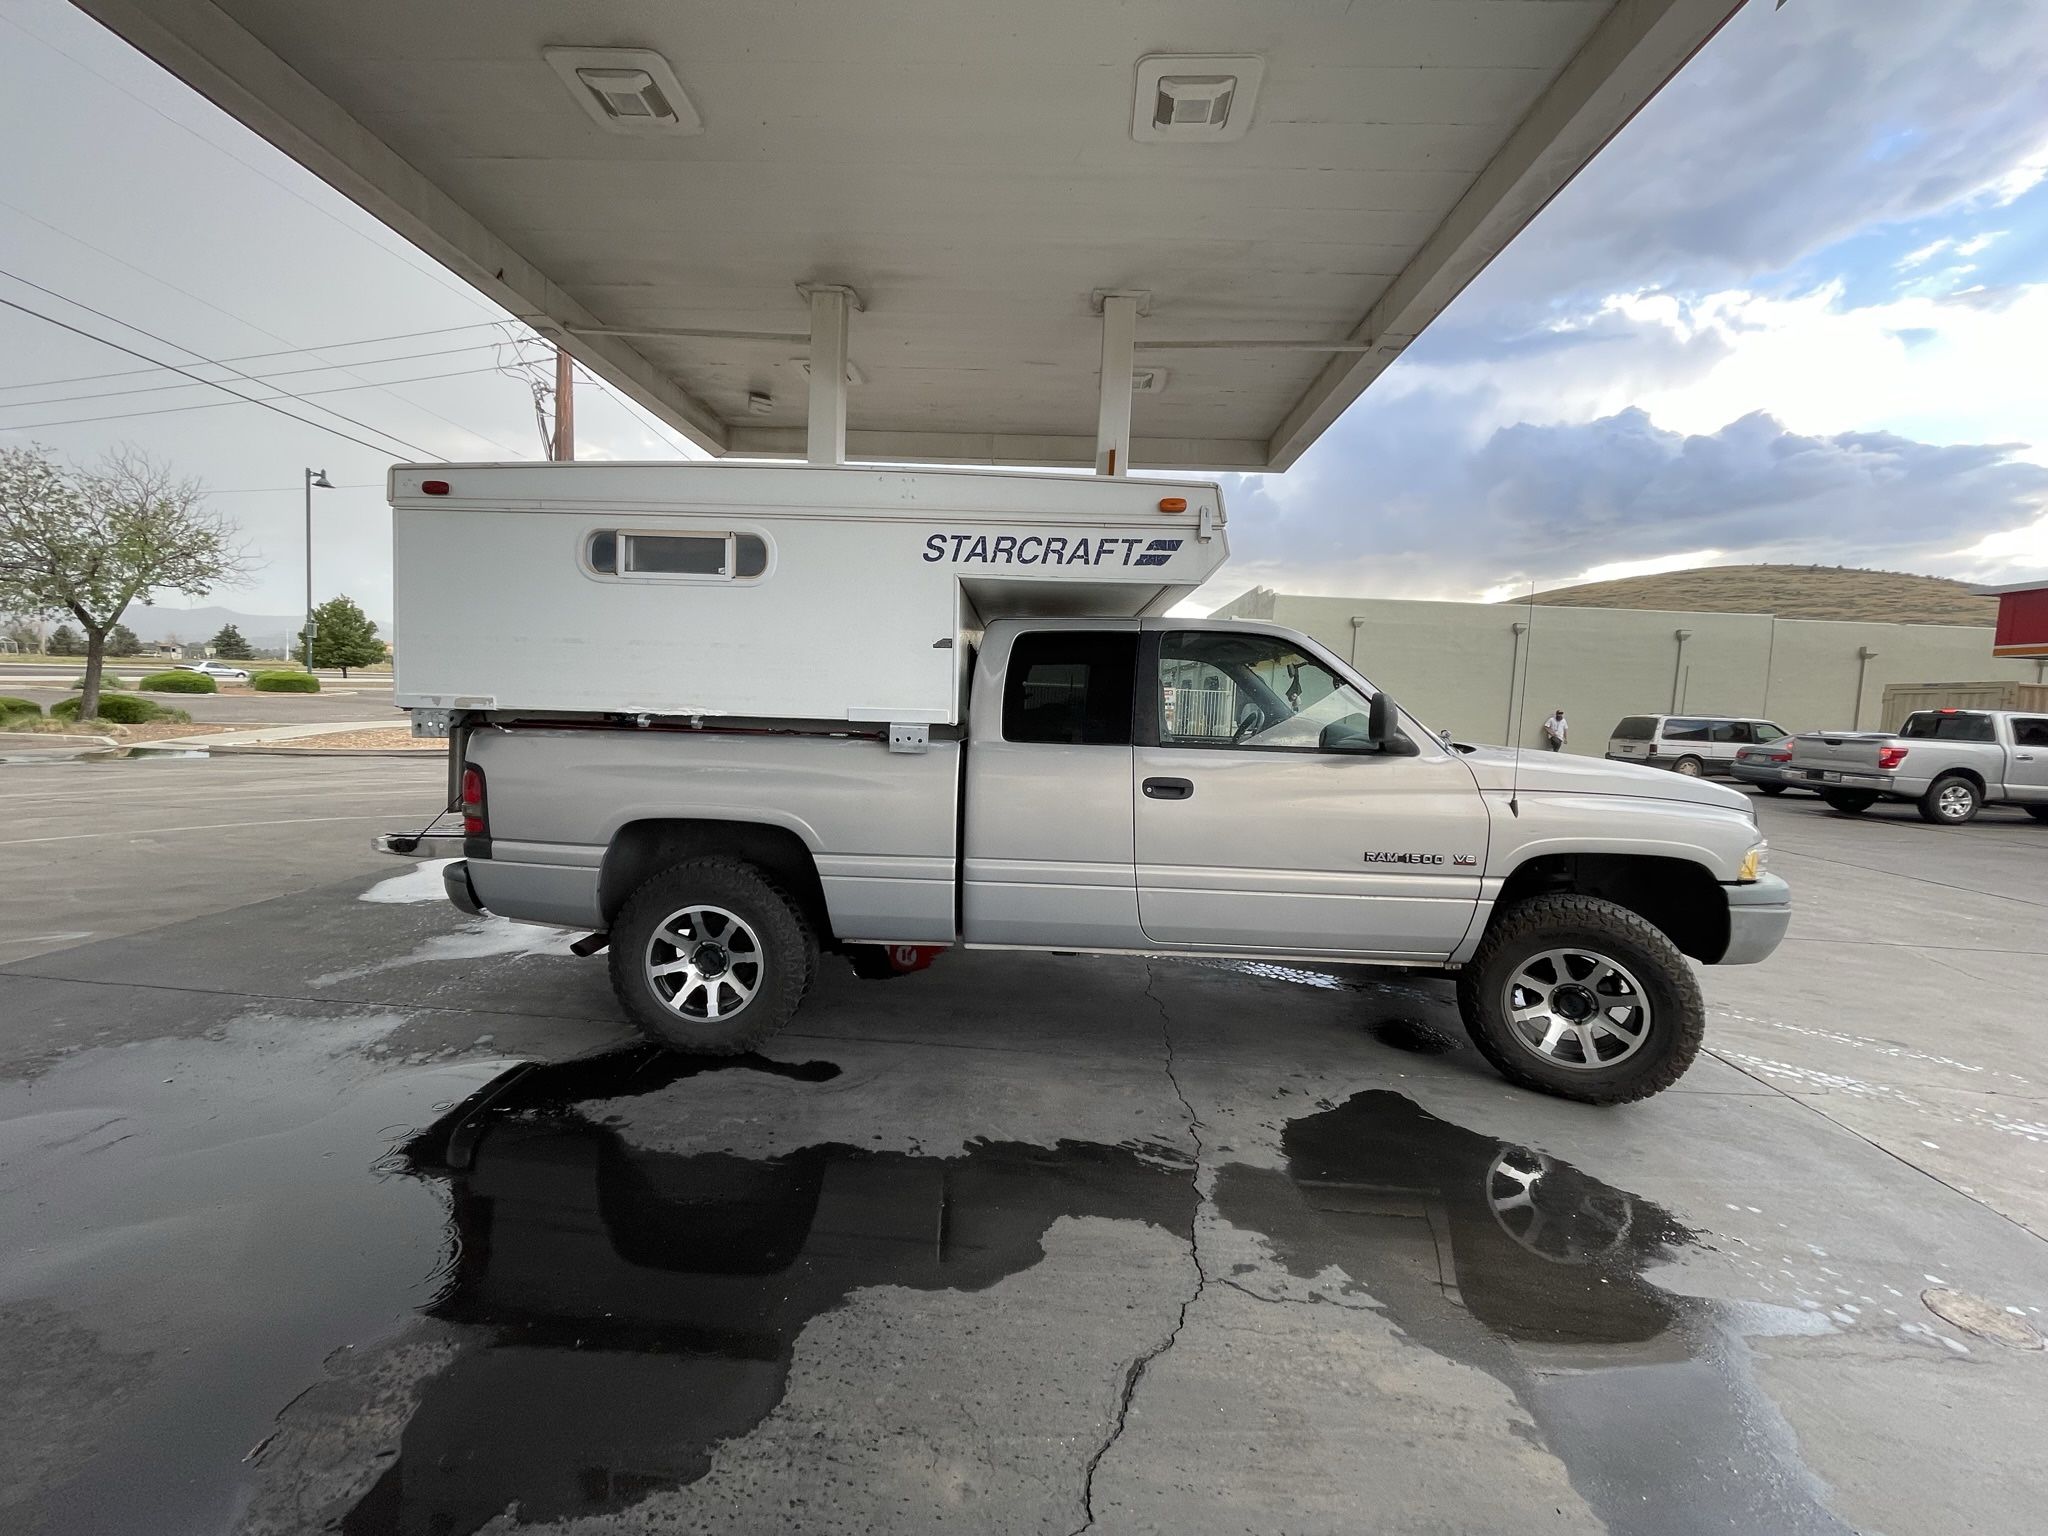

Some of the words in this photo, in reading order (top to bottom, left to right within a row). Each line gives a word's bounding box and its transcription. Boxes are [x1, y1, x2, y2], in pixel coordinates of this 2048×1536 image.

[922, 533, 1142, 566] STARCRAFT
[1364, 851, 1399, 863] RAM
[1404, 853, 1445, 865] 1500
